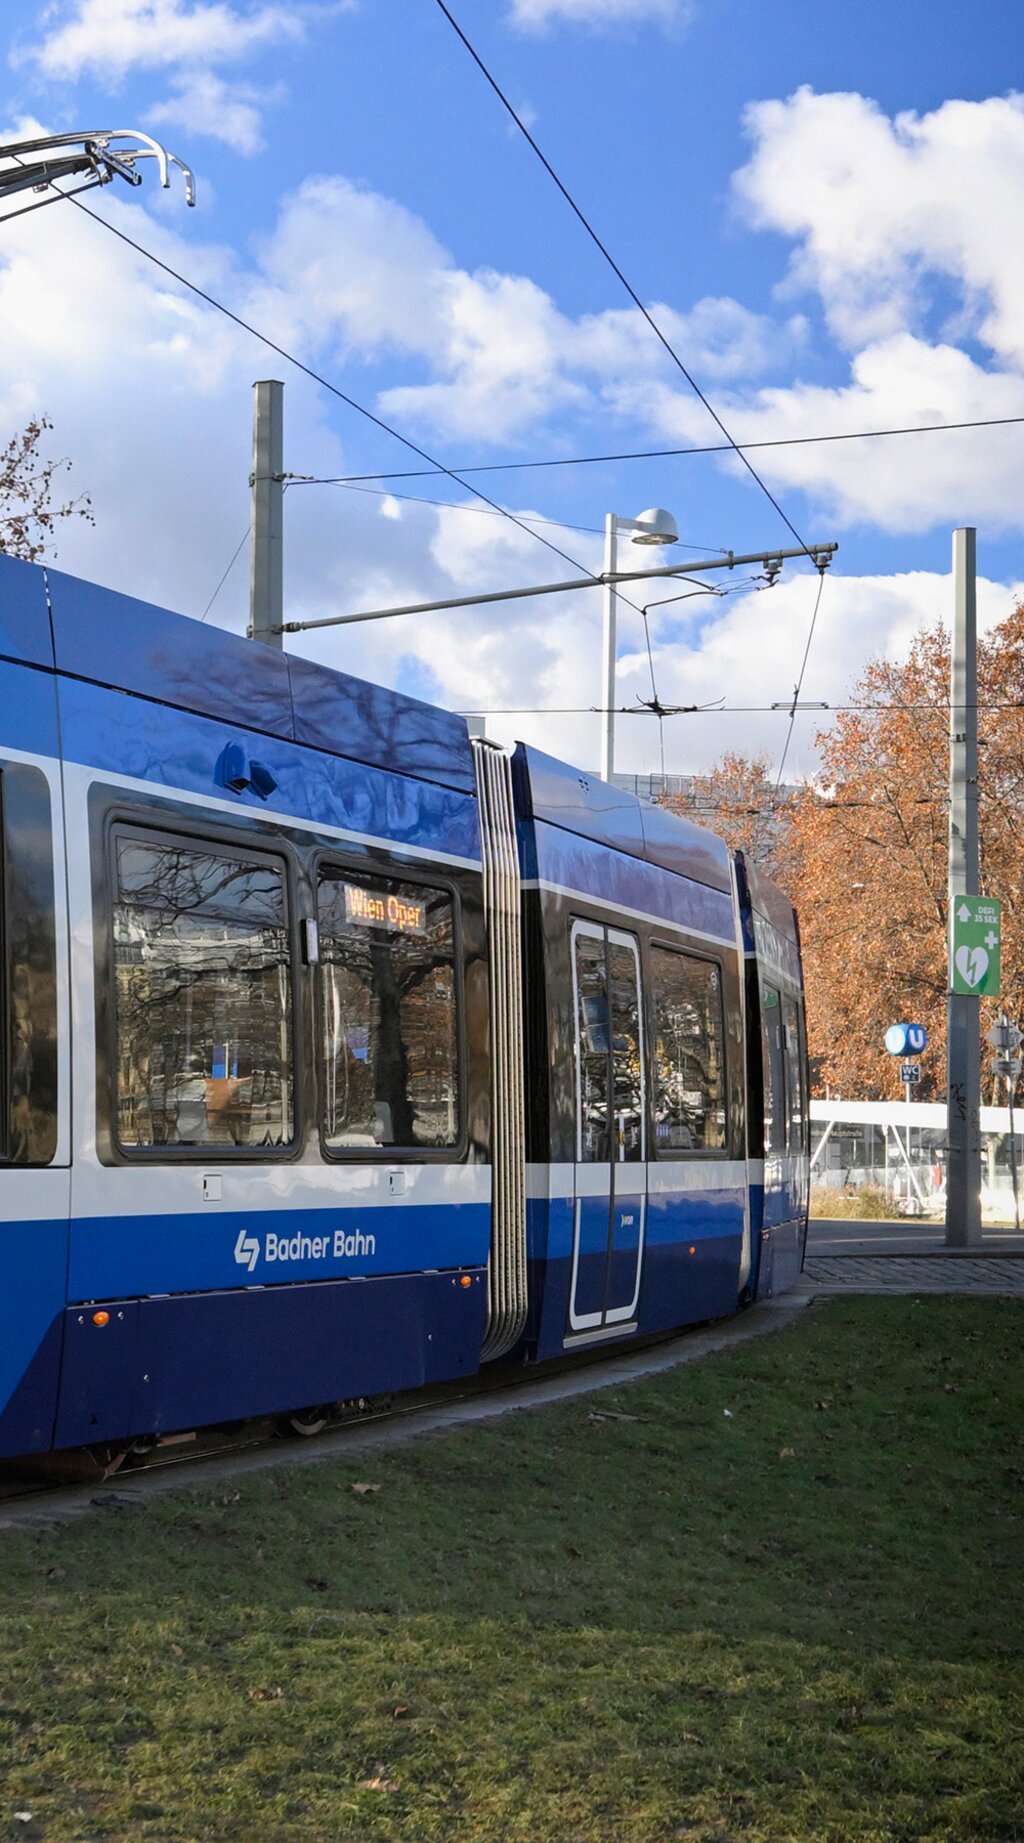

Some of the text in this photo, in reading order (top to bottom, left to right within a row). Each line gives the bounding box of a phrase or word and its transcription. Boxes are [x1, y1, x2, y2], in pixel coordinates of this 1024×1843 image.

[349, 888, 422, 930] Wien Oper
[978, 906, 995, 915] DEFI
[984, 915, 999, 924] SEK
[908, 1029, 924, 1048] U
[902, 1066, 919, 1075] WC
[265, 1229, 376, 1262] Badner Bahn
